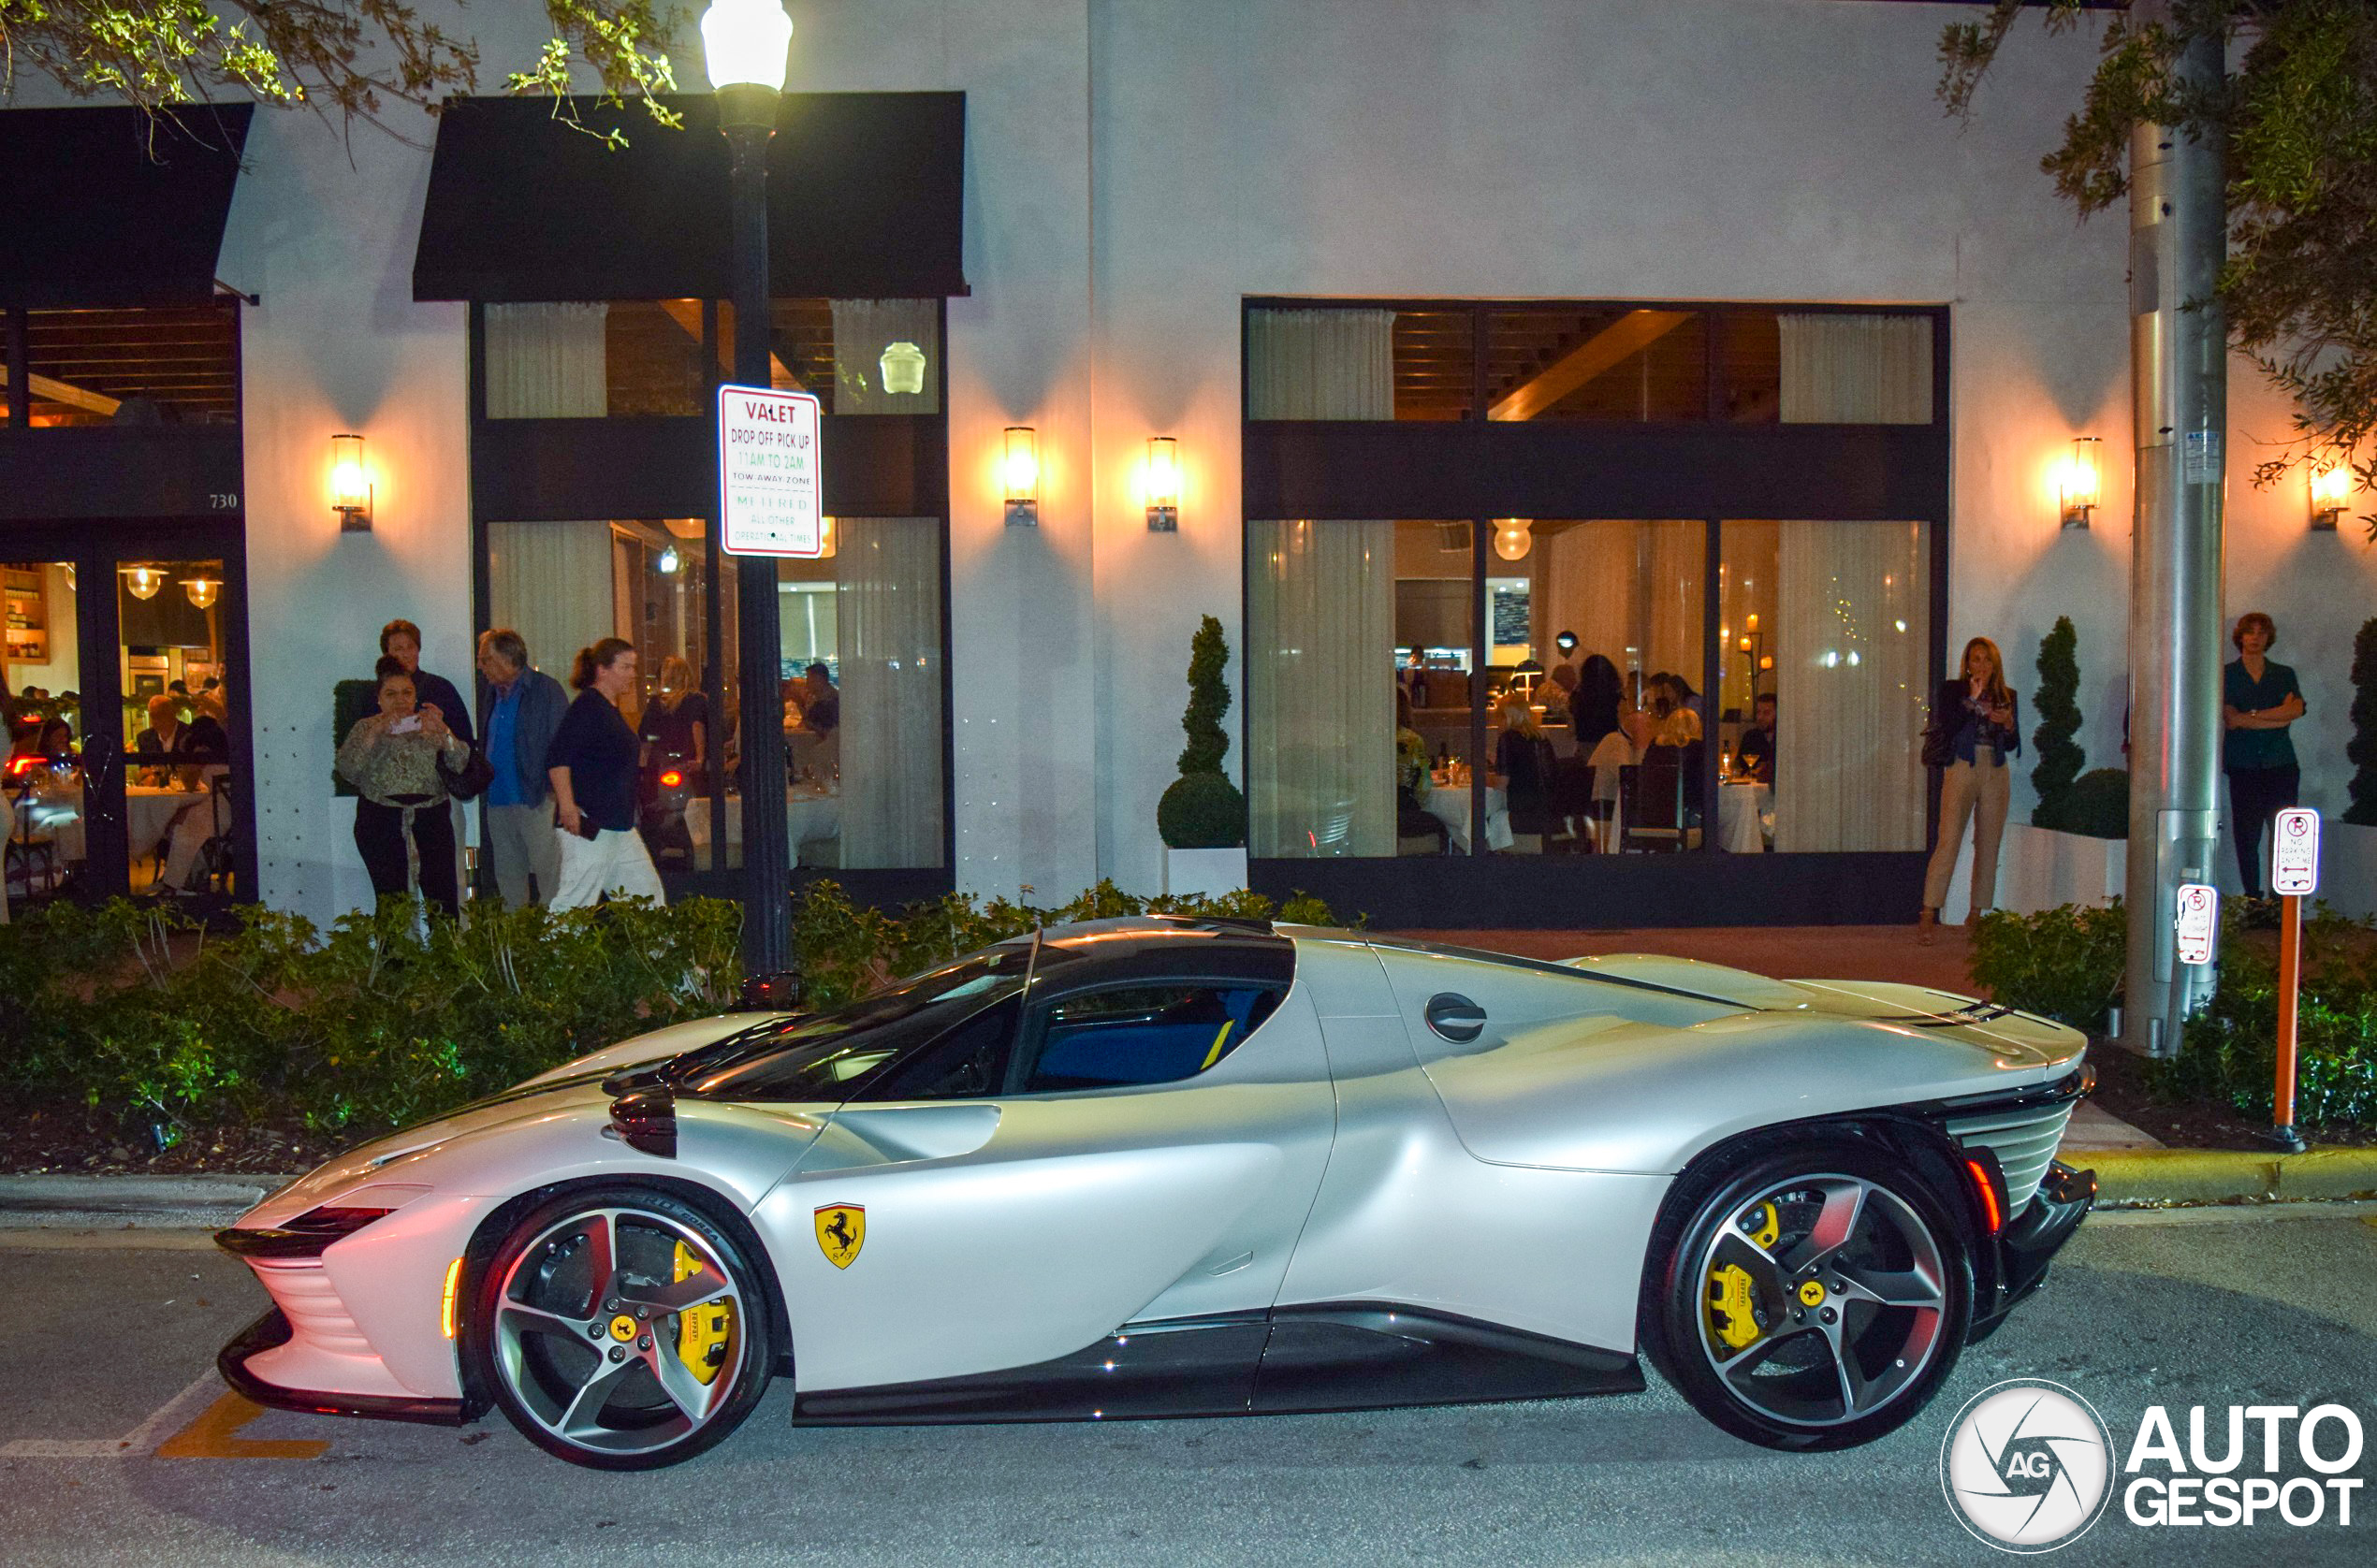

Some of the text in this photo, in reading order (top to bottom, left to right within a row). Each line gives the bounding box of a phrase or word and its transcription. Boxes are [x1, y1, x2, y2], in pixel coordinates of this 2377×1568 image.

[746, 401, 795, 424] VALET
[731, 428, 809, 450] DROP OFF PICK UP
[738, 451, 805, 471] 11AM TO 2AM
[733, 472, 810, 486] TOW AWAY ZONE
[210, 494, 238, 509] 730
[751, 514, 795, 526] ALL OTHER
[790, 533, 812, 544] TIMES
[681, 1212, 719, 1241] CORSA
